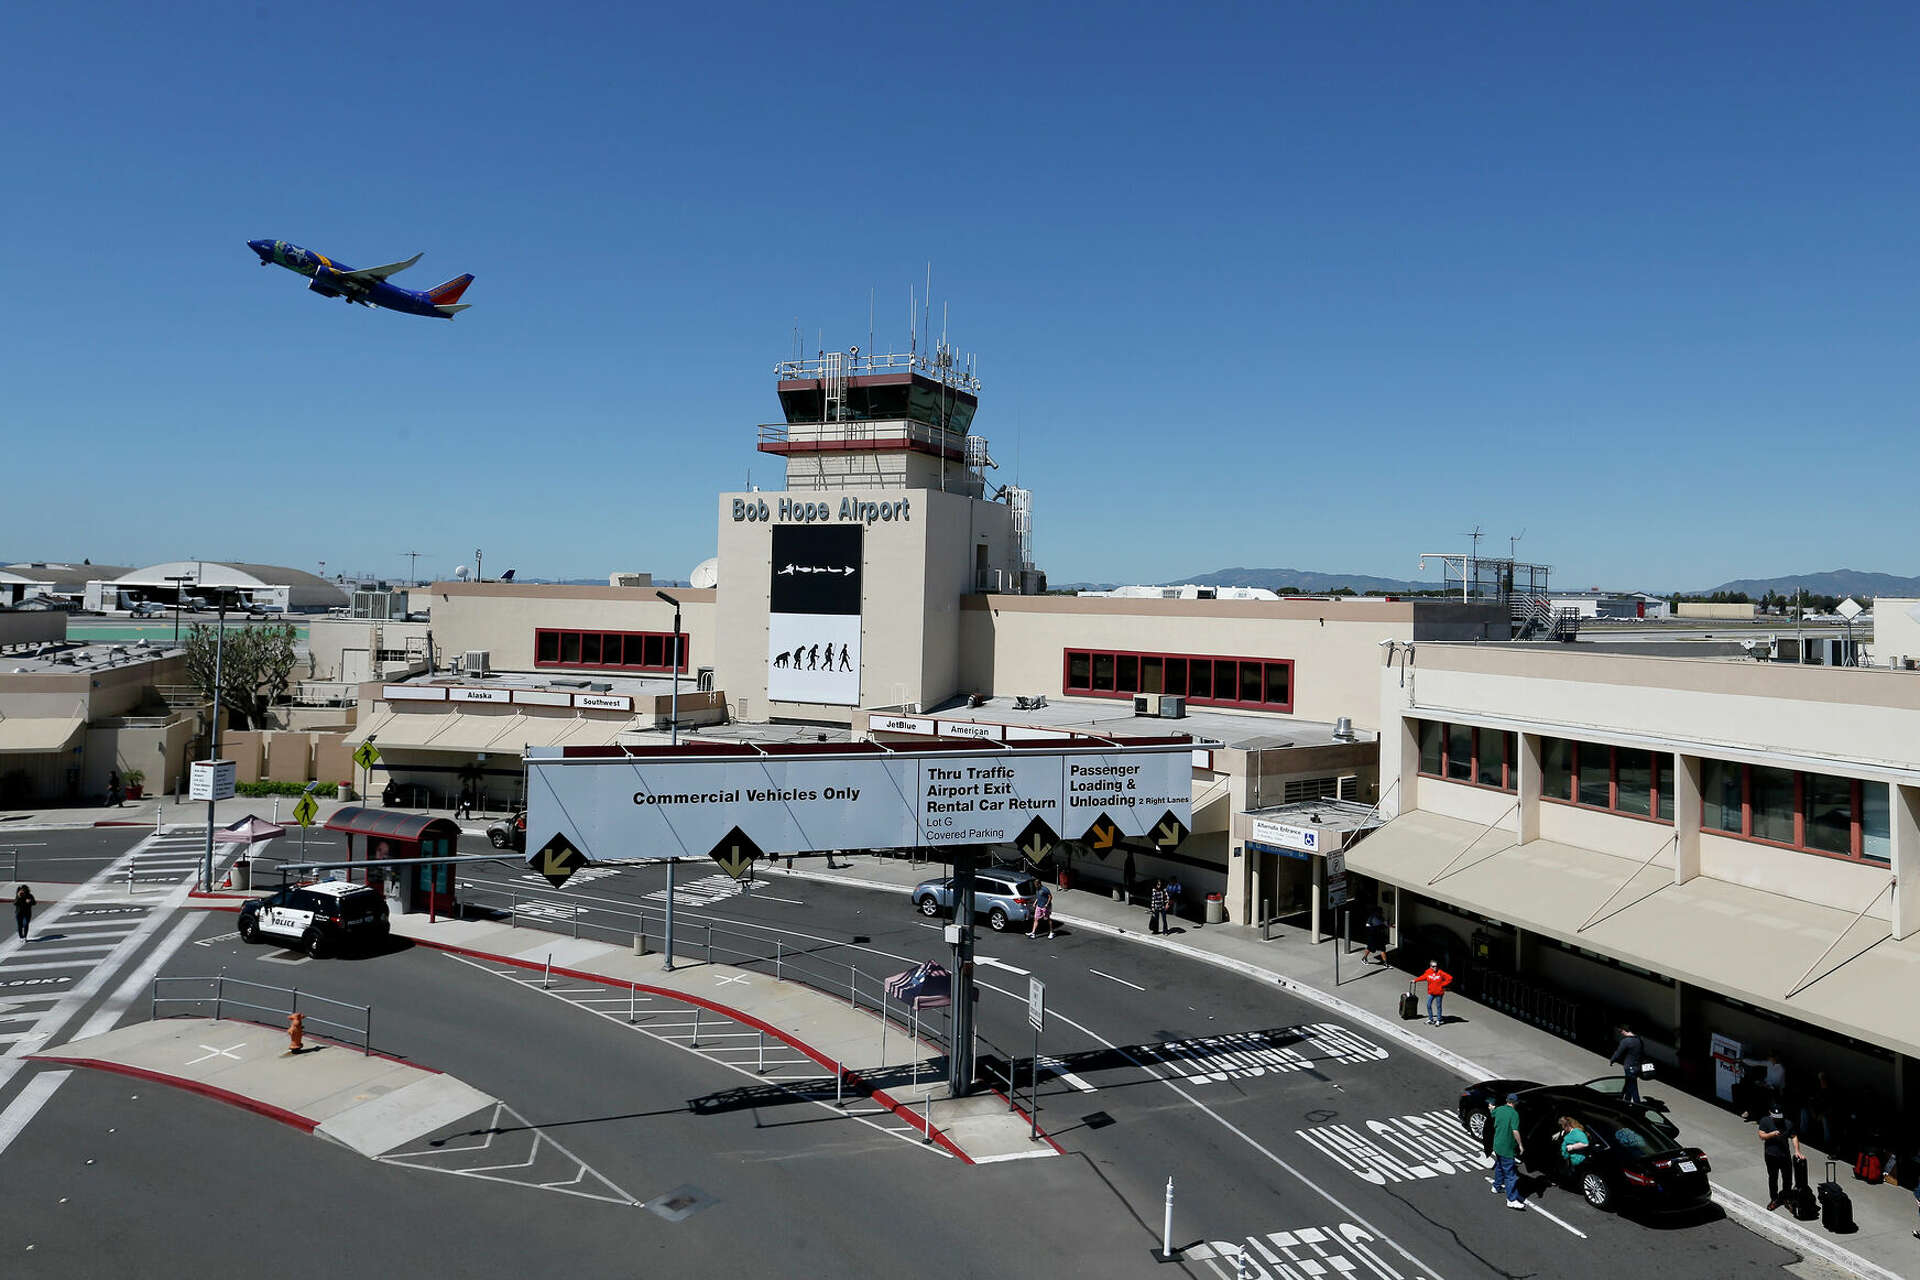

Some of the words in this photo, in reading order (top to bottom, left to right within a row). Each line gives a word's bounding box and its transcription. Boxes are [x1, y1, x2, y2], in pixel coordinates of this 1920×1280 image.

[732, 498, 769, 521] Bob
[778, 498, 829, 523] Hope
[838, 497, 910, 526] Airport
[467, 691, 492, 699] Alaska
[583, 697, 620, 707] Southwest
[886, 720, 917, 730] JetBlue
[950, 725, 989, 737] American
[927, 768, 962, 780] Thru
[967, 766, 1015, 779] Traffic
[1070, 765, 1140, 776] Passenger
[927, 783, 979, 798] Airport
[983, 783, 1011, 795] Exit
[1070, 780, 1123, 792] Loading
[1127, 779, 1136, 790] &
[633, 790, 740, 805] Commercial
[746, 788, 817, 802] Vehicles
[823, 786, 861, 802] Only
[1070, 795, 1136, 807] Unloading
[1145, 797, 1165, 806] Right
[1167, 796, 1189, 804] Lanes
[927, 800, 974, 813] Rental
[979, 799, 1004, 811] Car
[1009, 798, 1056, 810] Return
[926, 818, 942, 827] Lot
[944, 817, 953, 827] G
[926, 829, 966, 840] Covered
[969, 828, 1004, 839] Parking
[271, 918, 296, 928] POLICE
